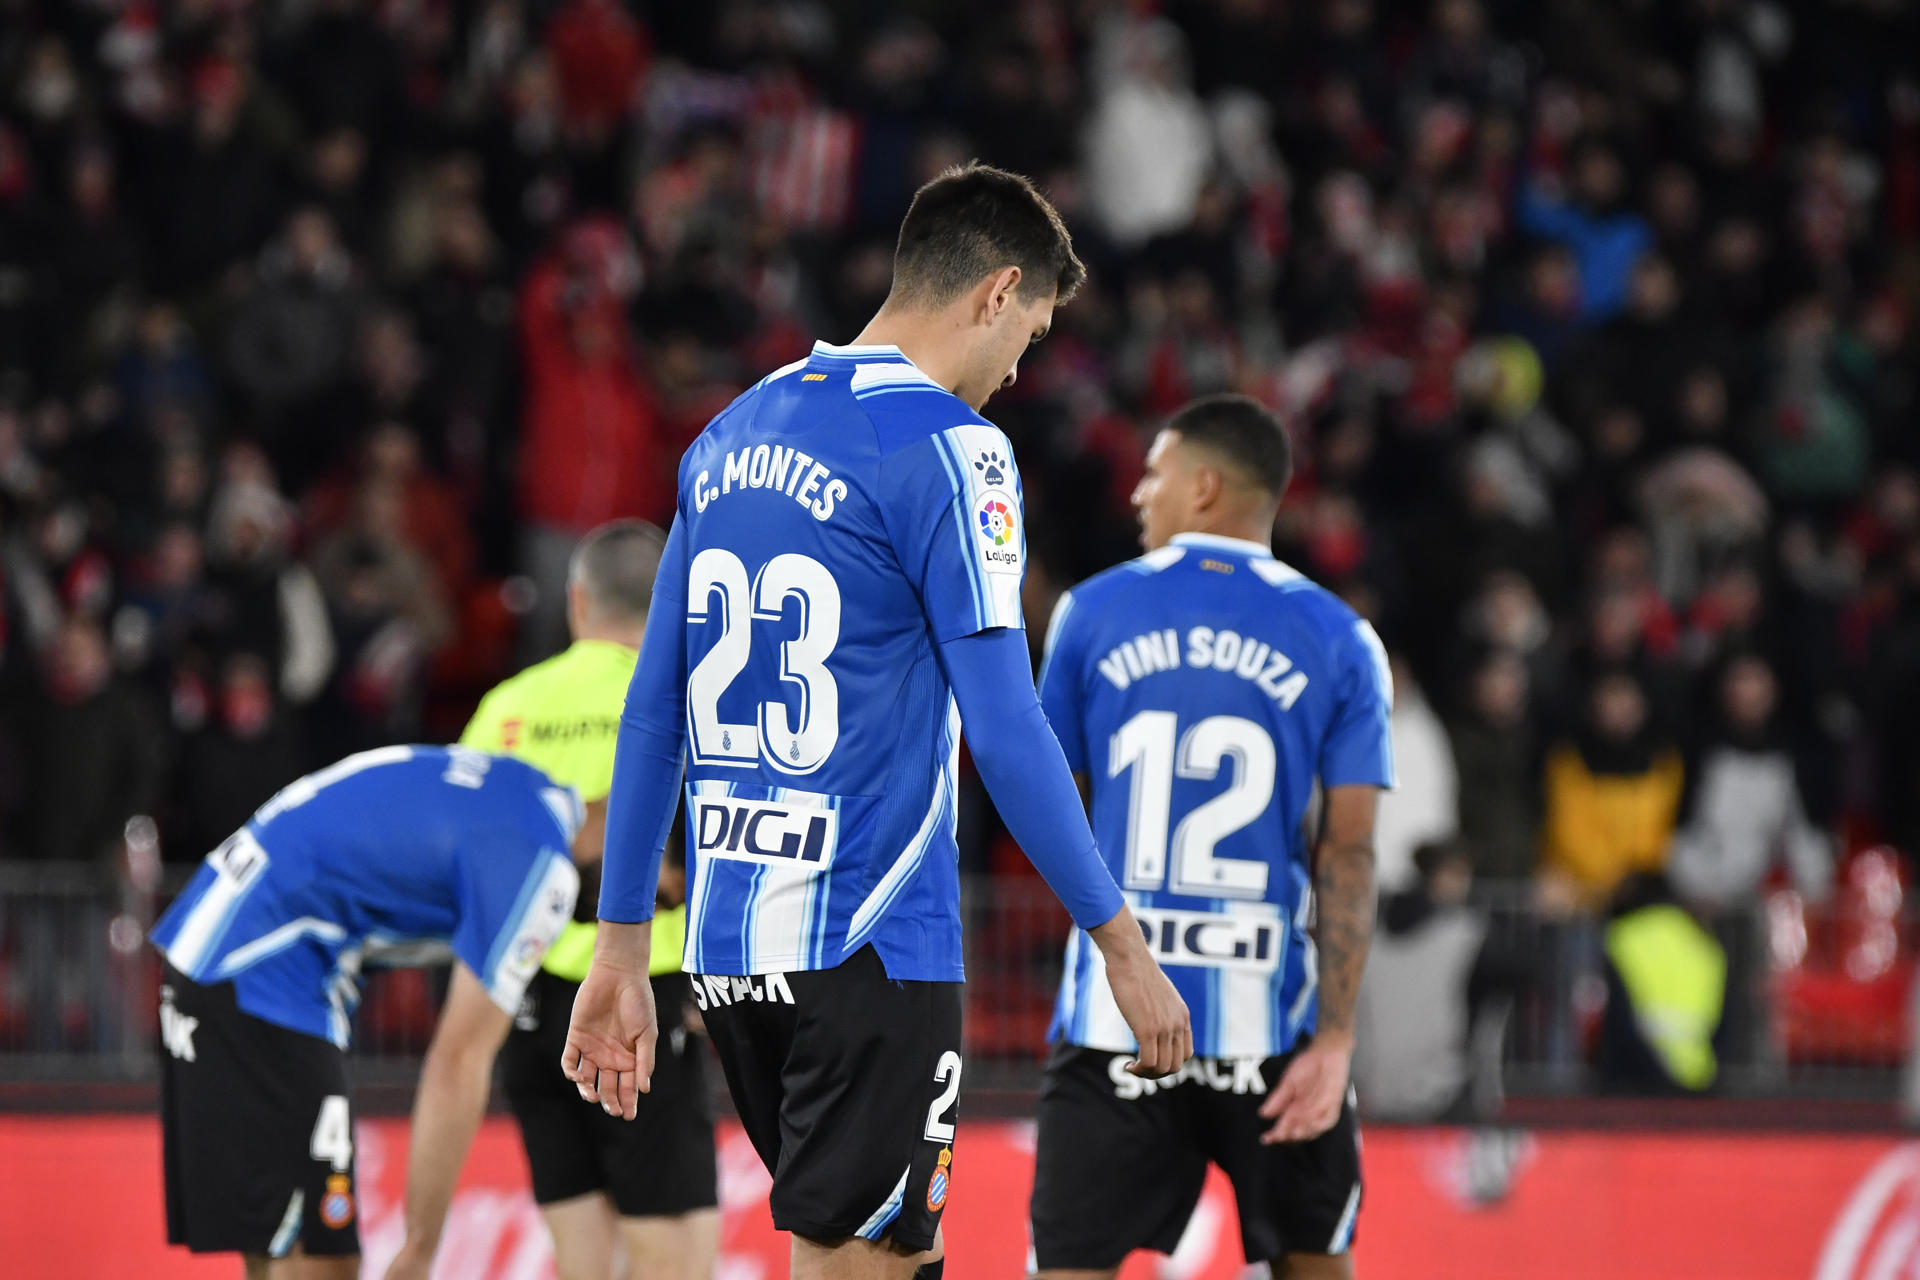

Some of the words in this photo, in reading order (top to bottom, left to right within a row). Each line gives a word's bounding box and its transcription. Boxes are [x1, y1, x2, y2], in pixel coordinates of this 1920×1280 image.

[695, 471, 719, 513] C.
[722, 444, 847, 521] MONTES
[985, 550, 1017, 564] LaLiga
[687, 548, 841, 775] 23
[1099, 629, 1180, 689] VINI
[1187, 627, 1308, 711] SOUZA
[699, 804, 826, 861] DIGI
[1108, 711, 1276, 898] 12
